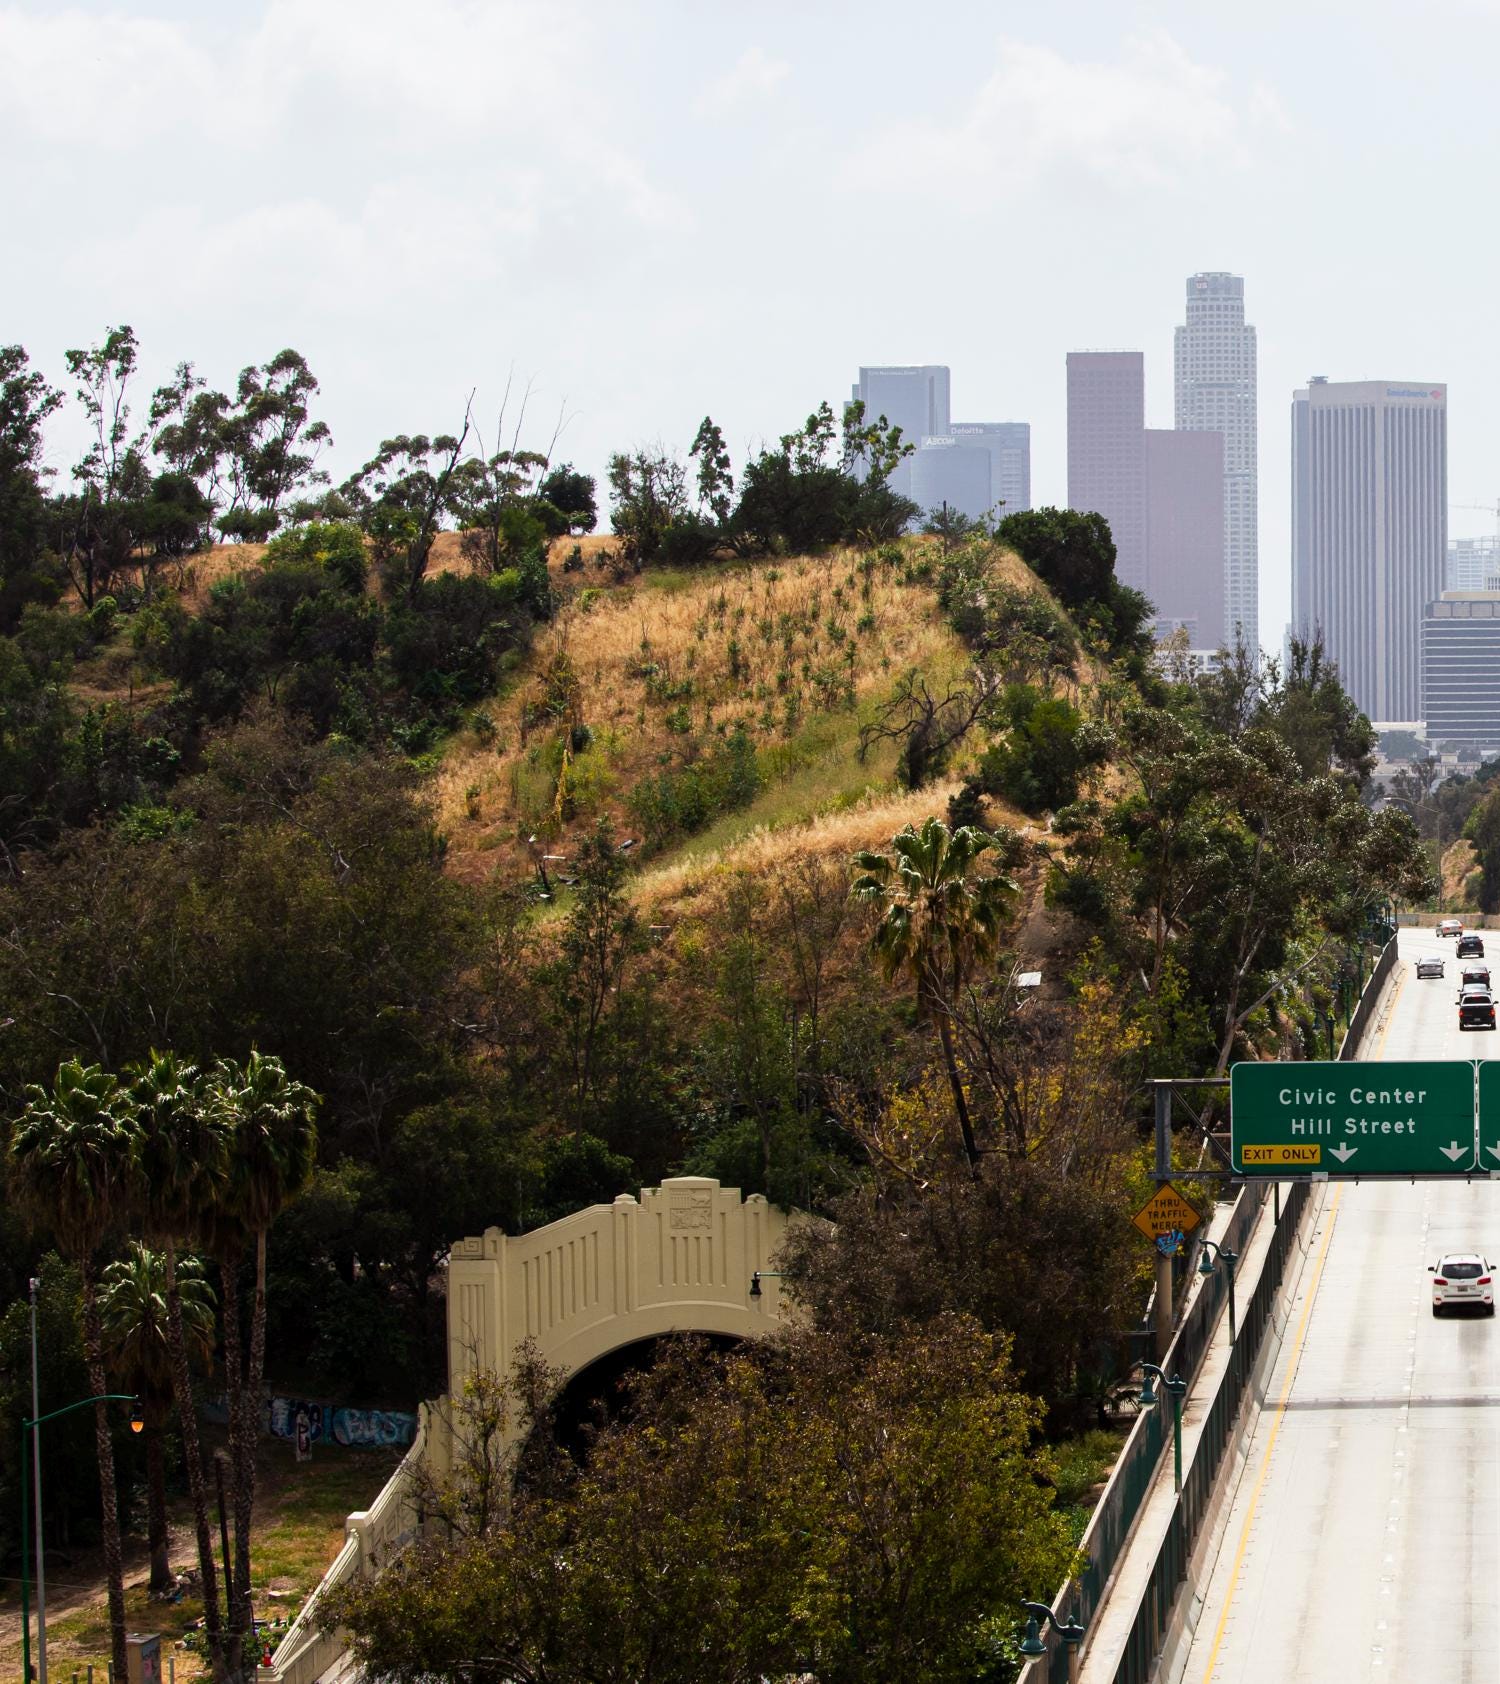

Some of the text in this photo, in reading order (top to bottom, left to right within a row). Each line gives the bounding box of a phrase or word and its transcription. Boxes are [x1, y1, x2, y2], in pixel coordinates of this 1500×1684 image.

[951, 426, 984, 434] Deloitte
[1279, 1087, 1427, 1105] Civic Center
[1292, 1117, 1416, 1135] Hill Street
[1244, 1148, 1318, 1160] EXIT ONLY
[1154, 1199, 1180, 1208] THRU
[1148, 1209, 1188, 1219] TRAFFIC
[1152, 1221, 1184, 1230] MERGE
